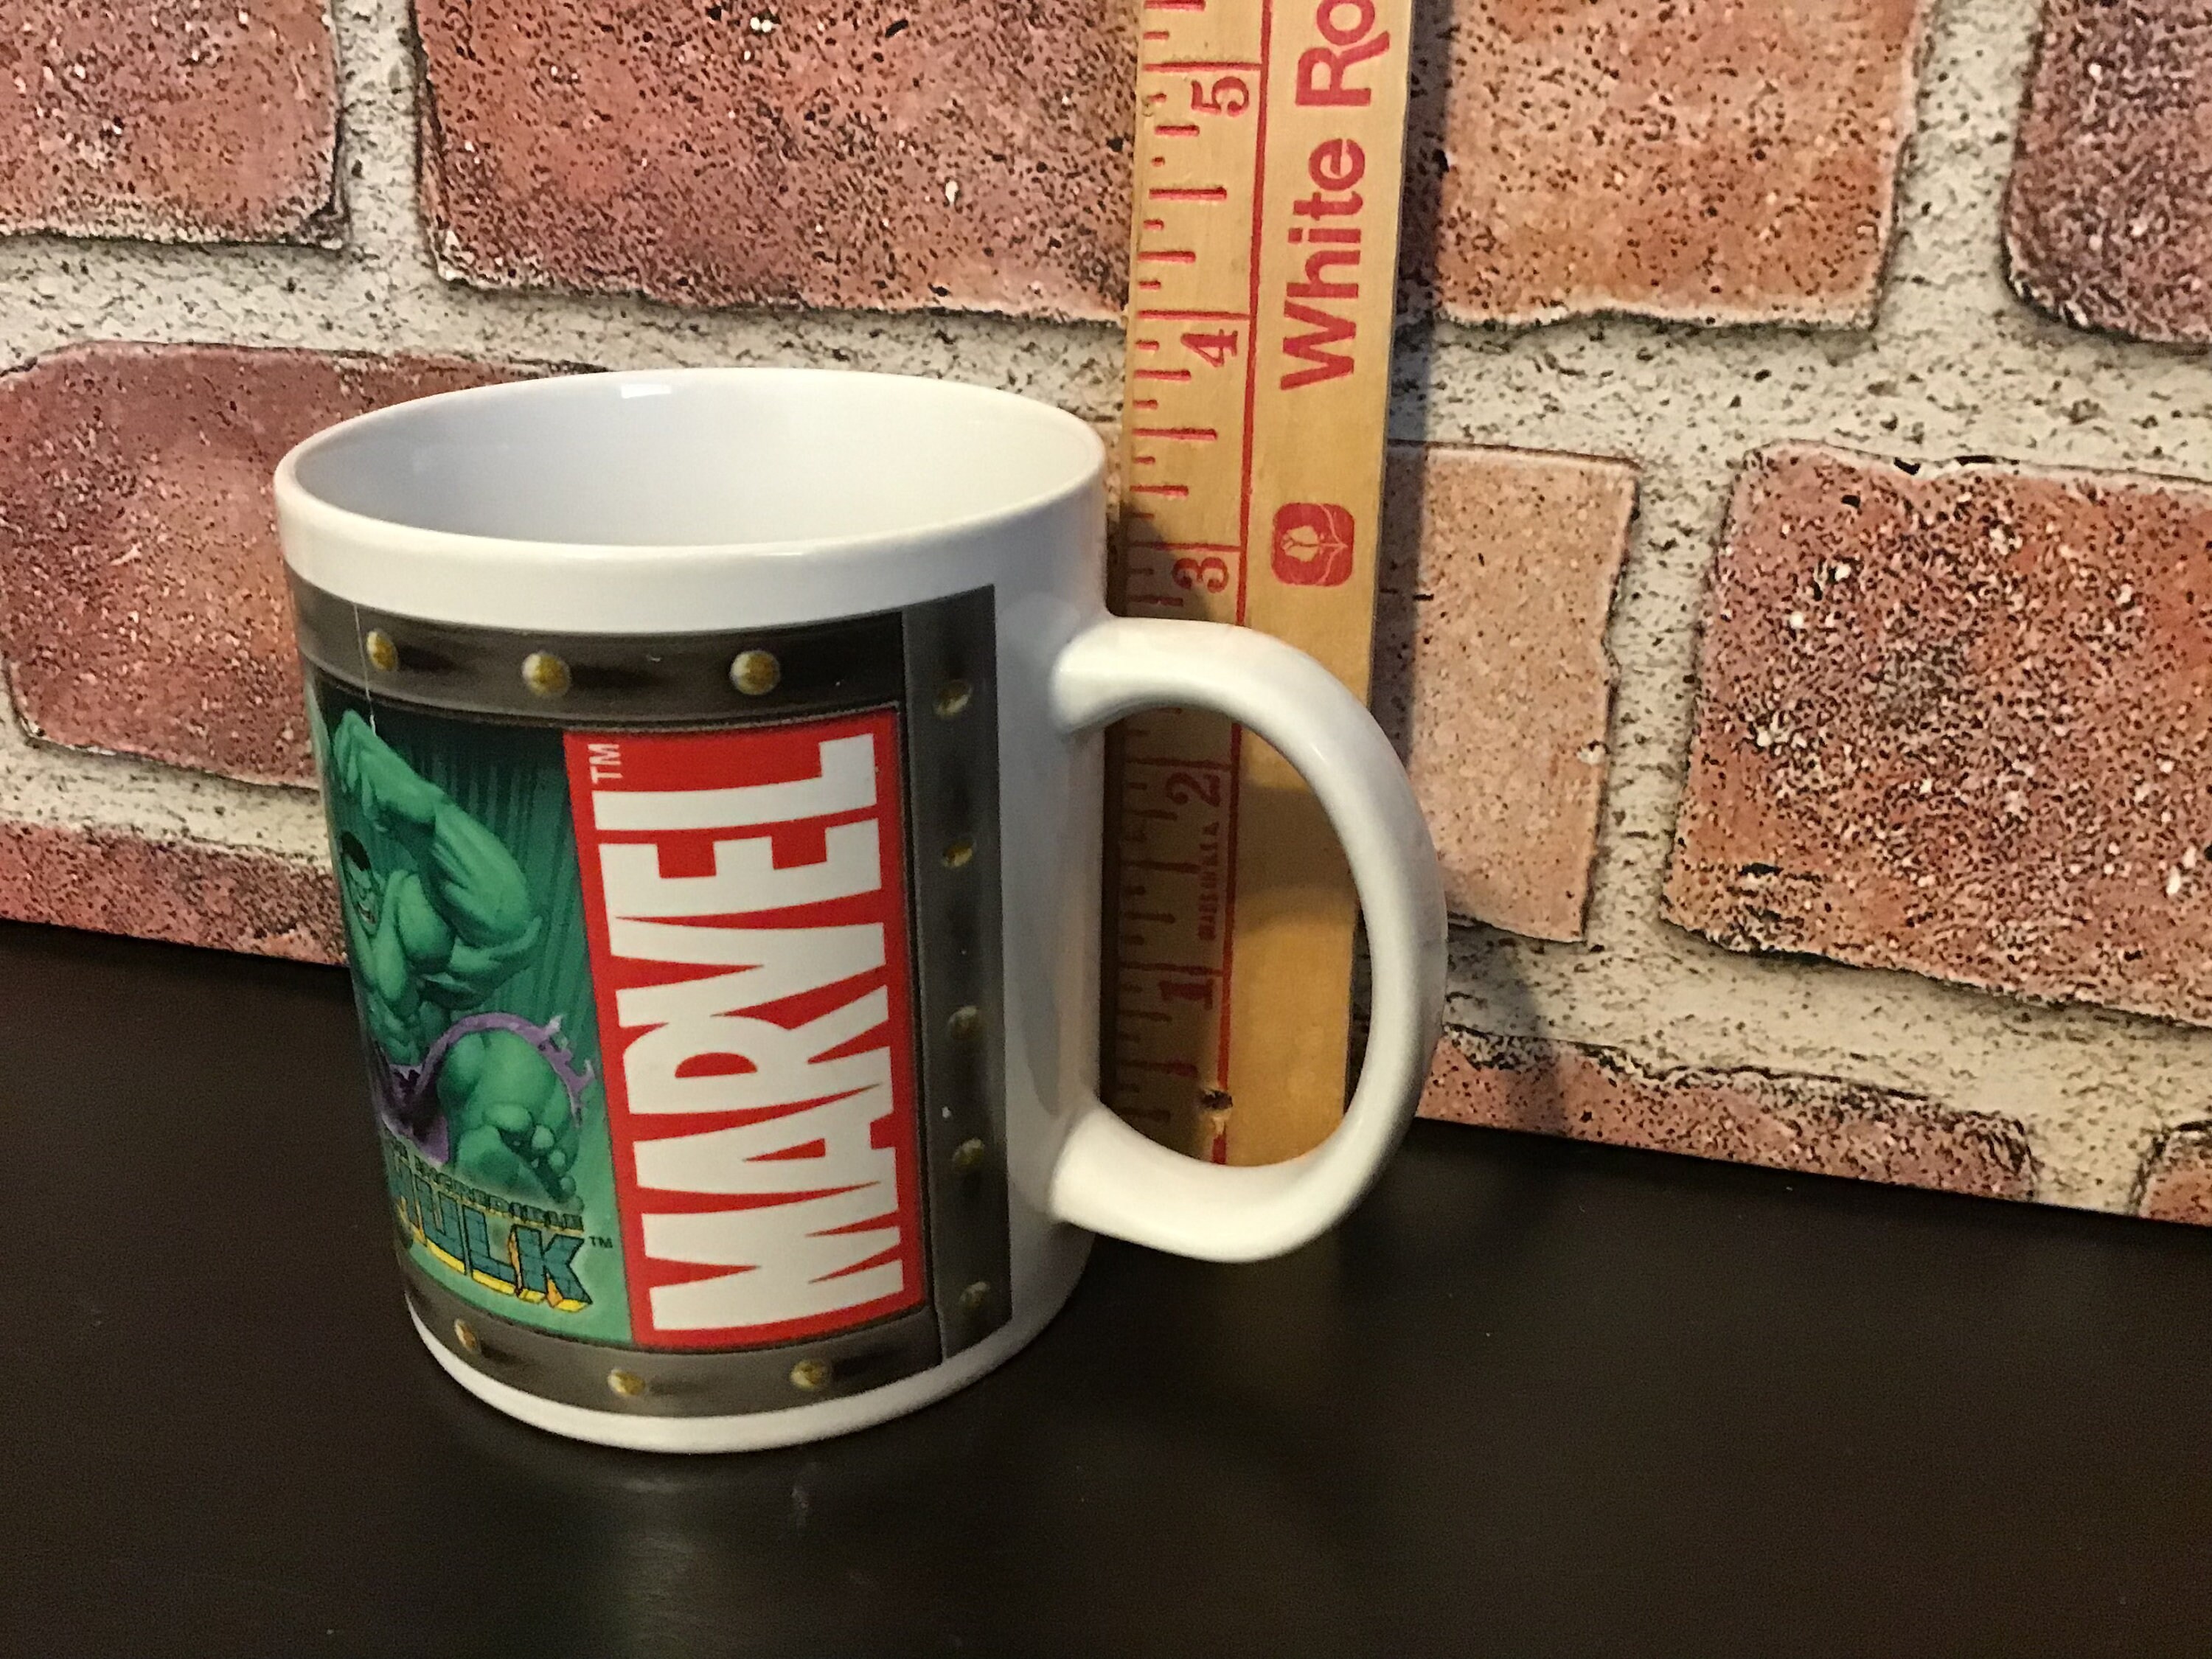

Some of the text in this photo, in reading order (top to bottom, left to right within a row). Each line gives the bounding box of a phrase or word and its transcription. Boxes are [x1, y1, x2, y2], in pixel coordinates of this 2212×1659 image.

[1190, 76, 1250, 117] 5
[1279, 138, 1366, 390] White
[1180, 329, 1238, 367] 4
[1172, 556, 1229, 594] 3
[1165, 771, 1221, 807] 2
[1158, 978, 1213, 1011] 1
[591, 733, 905, 1330] MARVEL
